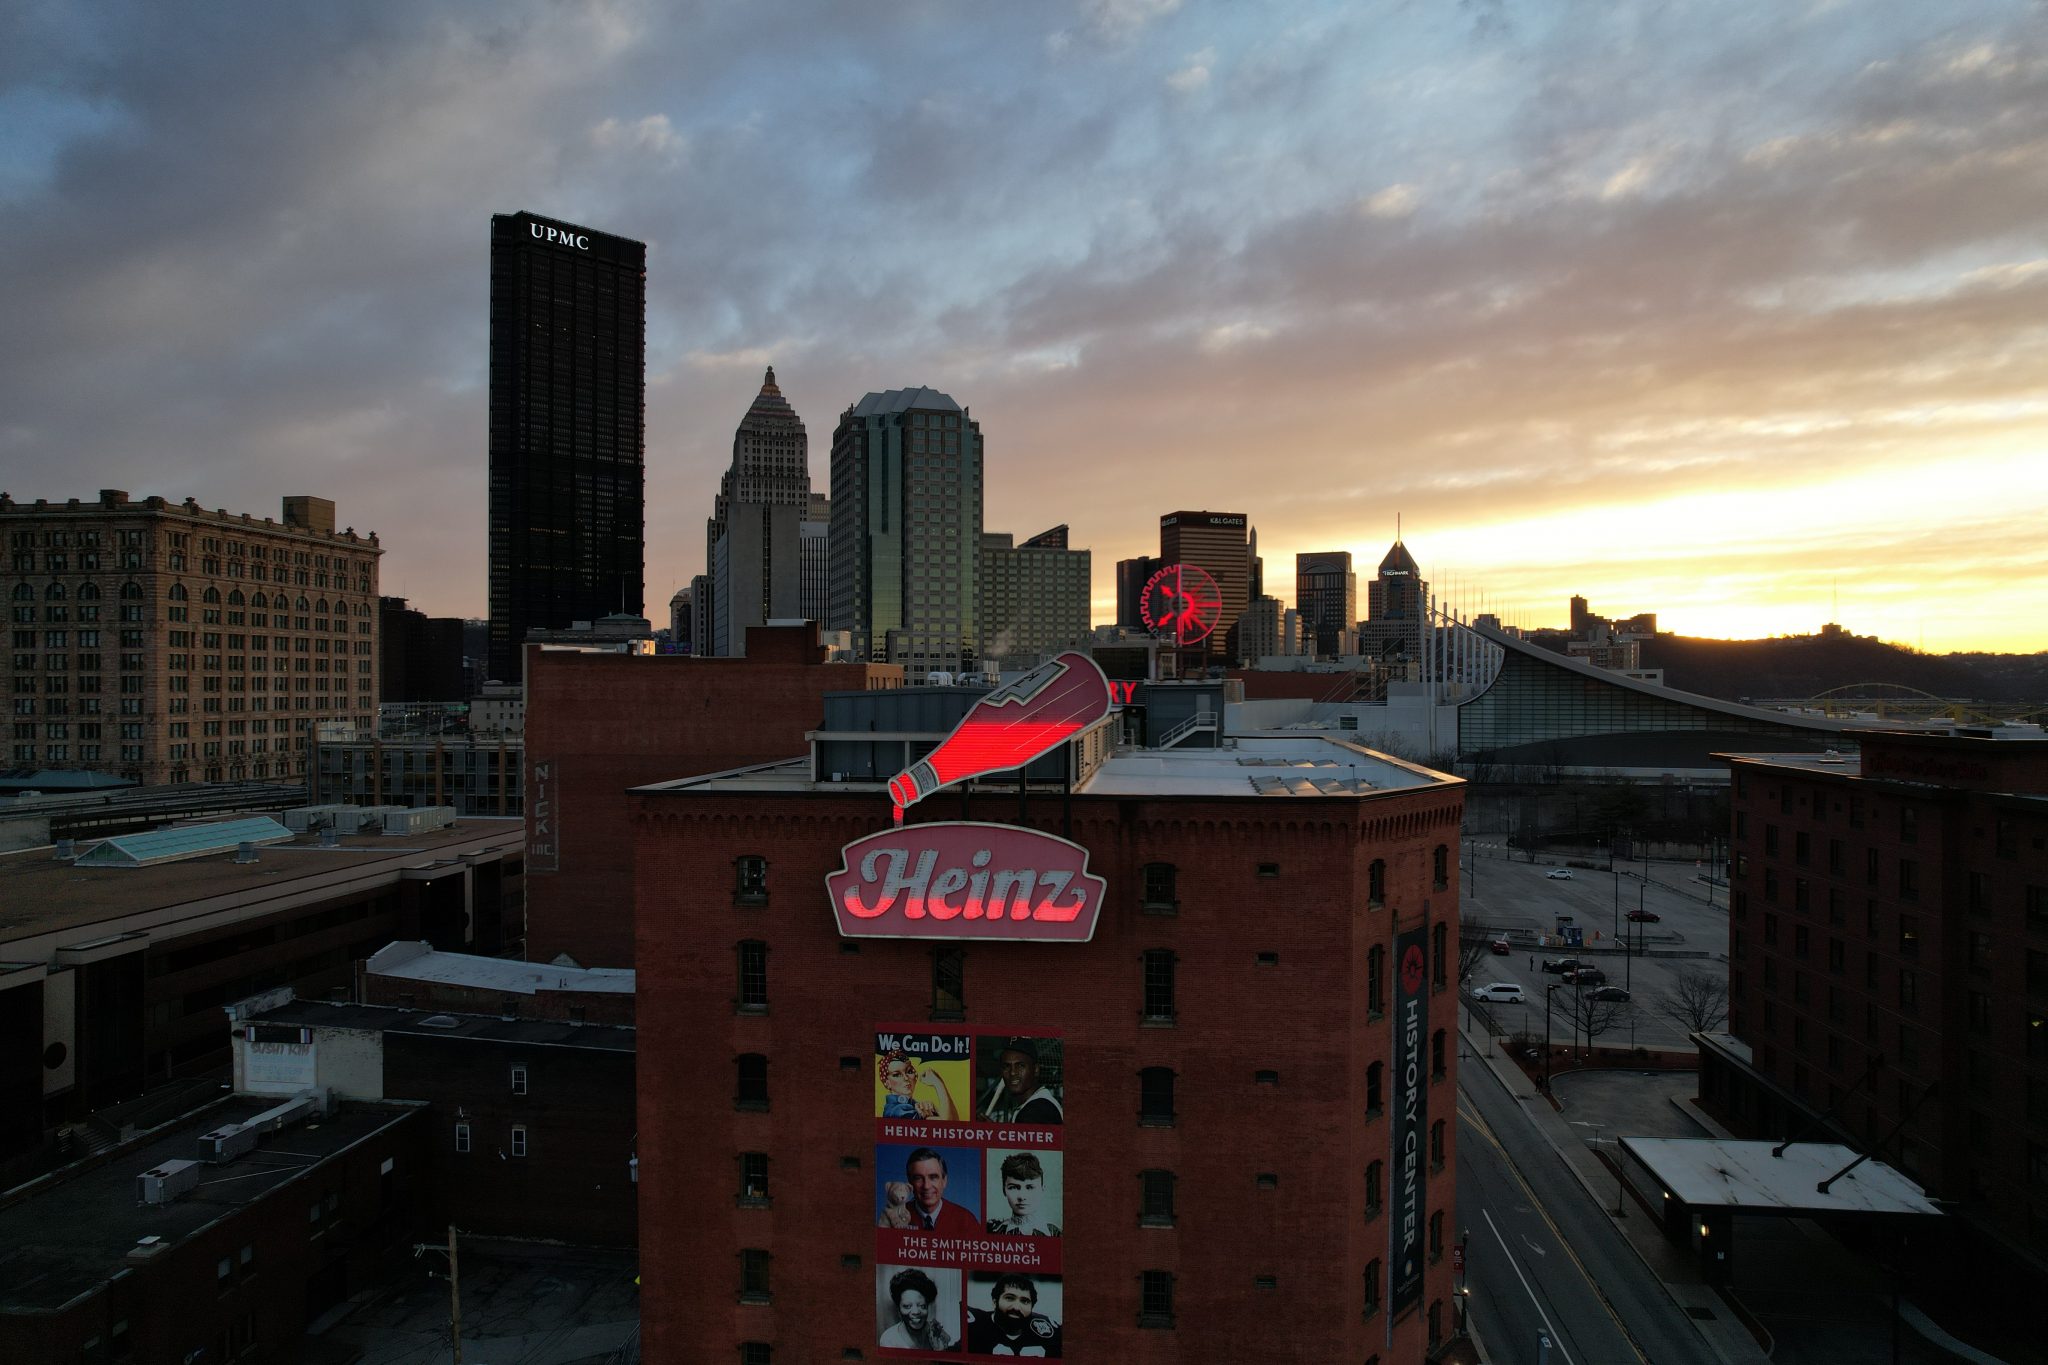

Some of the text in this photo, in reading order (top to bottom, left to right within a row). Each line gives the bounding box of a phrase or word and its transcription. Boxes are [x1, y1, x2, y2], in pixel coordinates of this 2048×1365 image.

[530, 222, 589, 250] UPMC
[844, 848, 1088, 922] Heinz
[878, 1033, 970, 1054] We Can Do It!
[884, 1125, 1054, 1143] HEINZ HISTORY CENTER
[1403, 999, 1418, 1253] HISTORY CENTER
[903, 1236, 1036, 1253] THE SMITHSONIAN'S
[898, 1248, 1041, 1265] HOME IN PITTSBURGH
